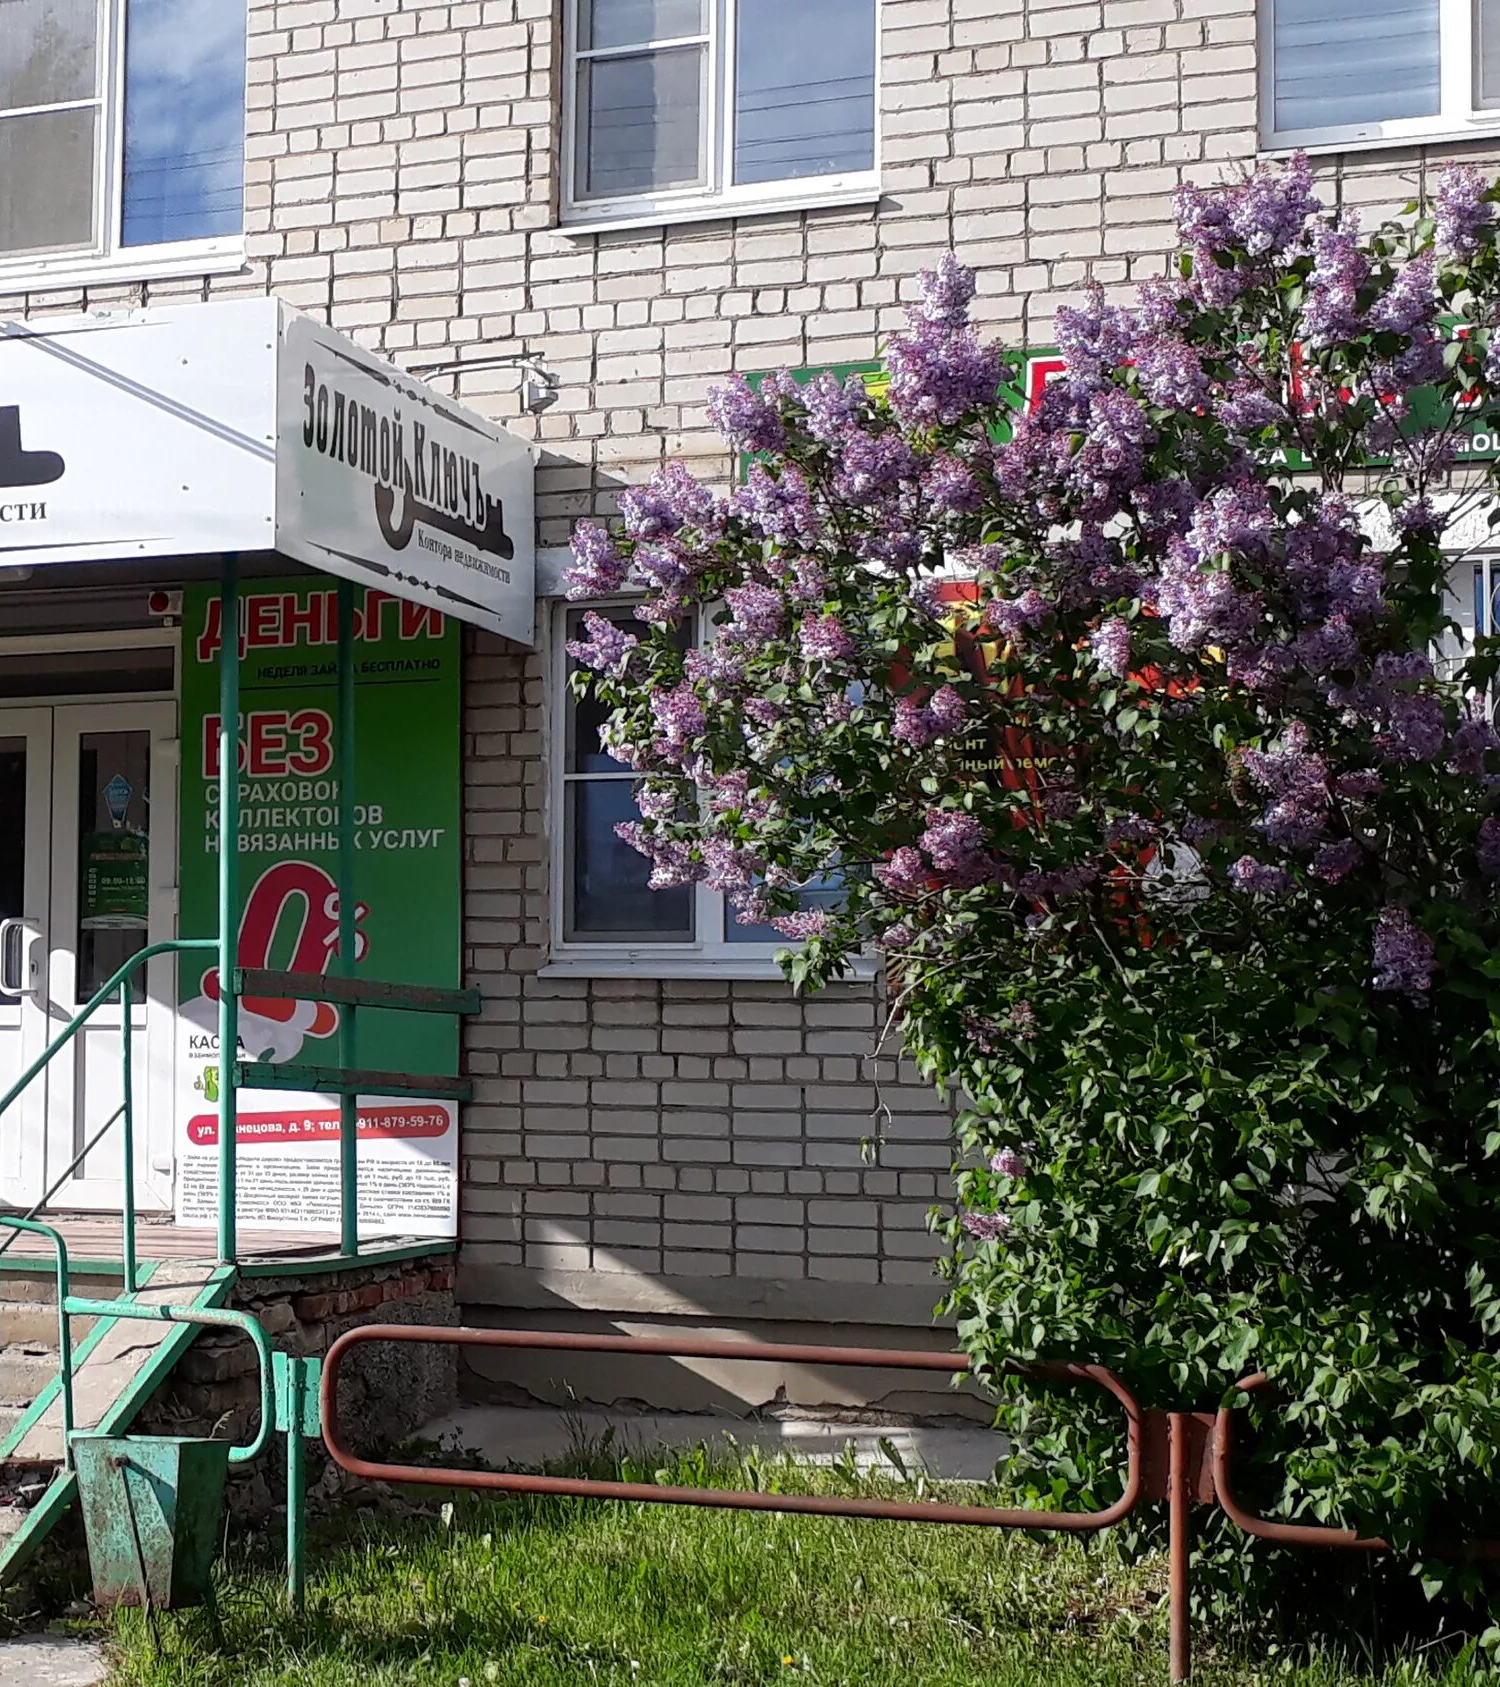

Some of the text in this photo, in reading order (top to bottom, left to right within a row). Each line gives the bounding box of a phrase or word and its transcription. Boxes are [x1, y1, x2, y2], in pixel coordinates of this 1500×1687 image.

[417, 528, 453, 561] Контора
[197, 589, 446, 662] ДЕНЬГИ
[257, 659, 441, 680] НЕДЕЛЯ ЗАЙА БЕСПЛАТНО
[202, 709, 333, 779] БЕЗ
[205, 782, 339, 804] СРАХОВО
[205, 805, 383, 829] КЛЛЕКТООВ
[370, 829, 445, 850] УСЛУГ
[189, 1034, 245, 1050] КАСА
[197, 1124, 215, 1138] ул.
[288, 1119, 301, 1134] д.
[303, 1118, 315, 1134] 9;
